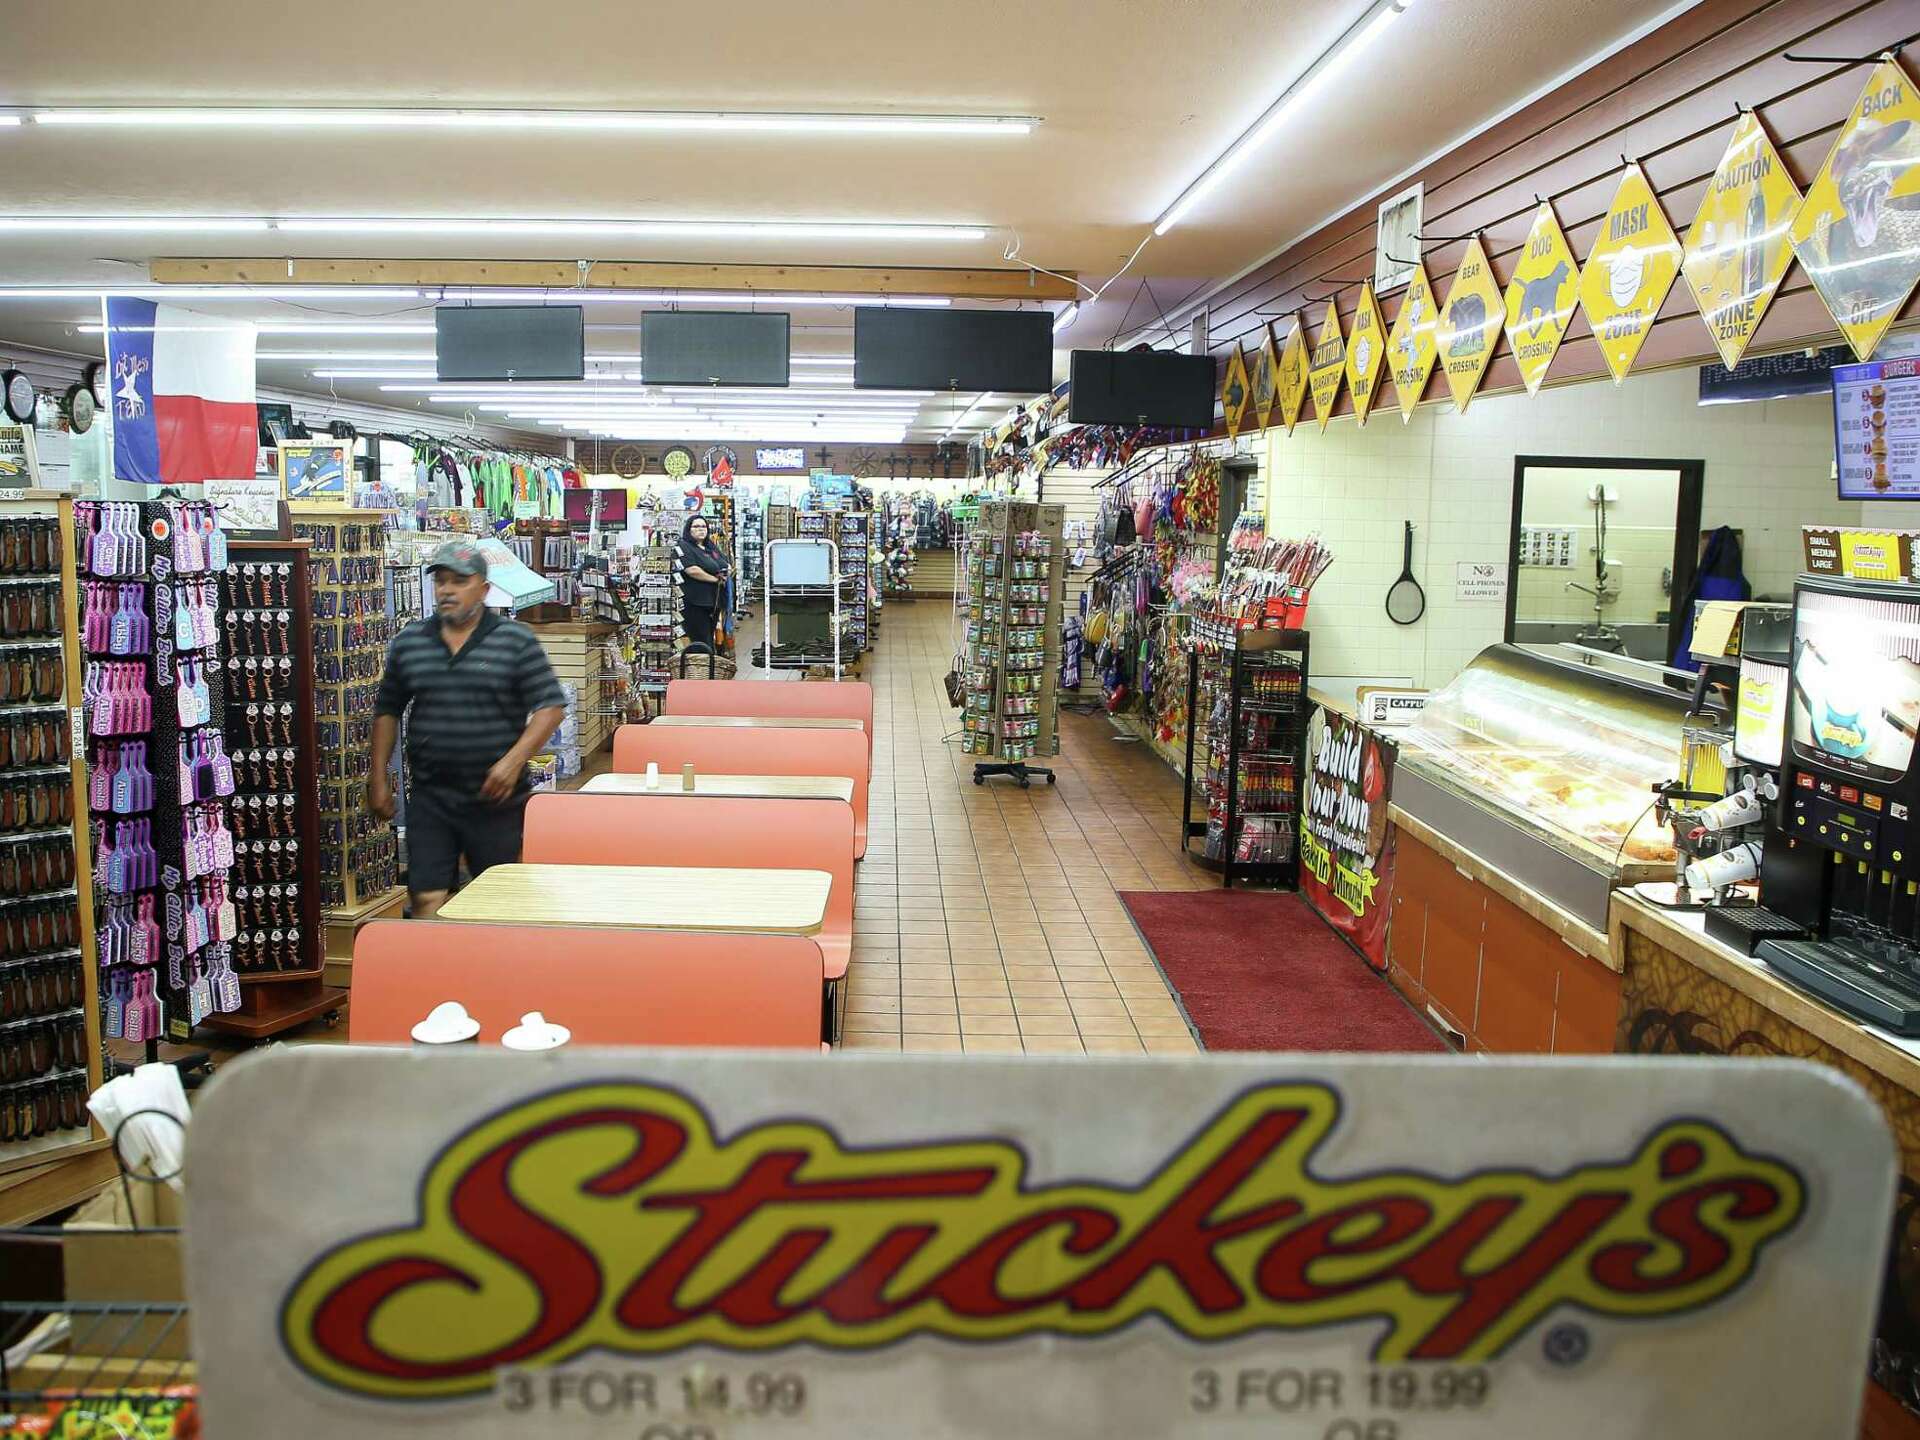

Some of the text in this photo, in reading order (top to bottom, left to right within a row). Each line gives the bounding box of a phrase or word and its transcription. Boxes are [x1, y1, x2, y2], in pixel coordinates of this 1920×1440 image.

[1861, 84, 1902, 117] BACK
[1715, 155, 1771, 194] CAUTION
[1609, 203, 1649, 241] MASK
[1531, 235, 1553, 260] DOG
[1462, 263, 1480, 280] BEAR
[1714, 301, 1755, 328] WINE
[1851, 302, 1879, 326] OFF
[1719, 323, 1748, 341] ZONE
[1315, 341, 1341, 367] CAUTION
[1518, 341, 1553, 360] CROSSING
[1449, 358, 1480, 375] CROSSING
[1884, 361, 1916, 378] BURGERS
[1809, 536, 1831, 546] SMALL
[1811, 548, 1837, 558] MEDIUM
[1811, 559, 1833, 569] LARGE
[151, 554, 174, 687] My Glitter Brush
[112, 621, 127, 650] Abby
[1391, 699, 1424, 708] CAPPU
[73, 716, 82, 734] FOR
[1318, 725, 1363, 784] Build
[117, 780, 127, 807] Anna
[1337, 784, 1369, 834] Own
[1319, 852, 1328, 881] In
[161, 864, 185, 990] My Glitter Brush
[287, 1086, 1802, 1395] Stuckey's
[504, 1371, 534, 1414] 3
[550, 1371, 658, 1416] FOR
[1191, 1367, 1489, 1412] 3 FOR 19.99
